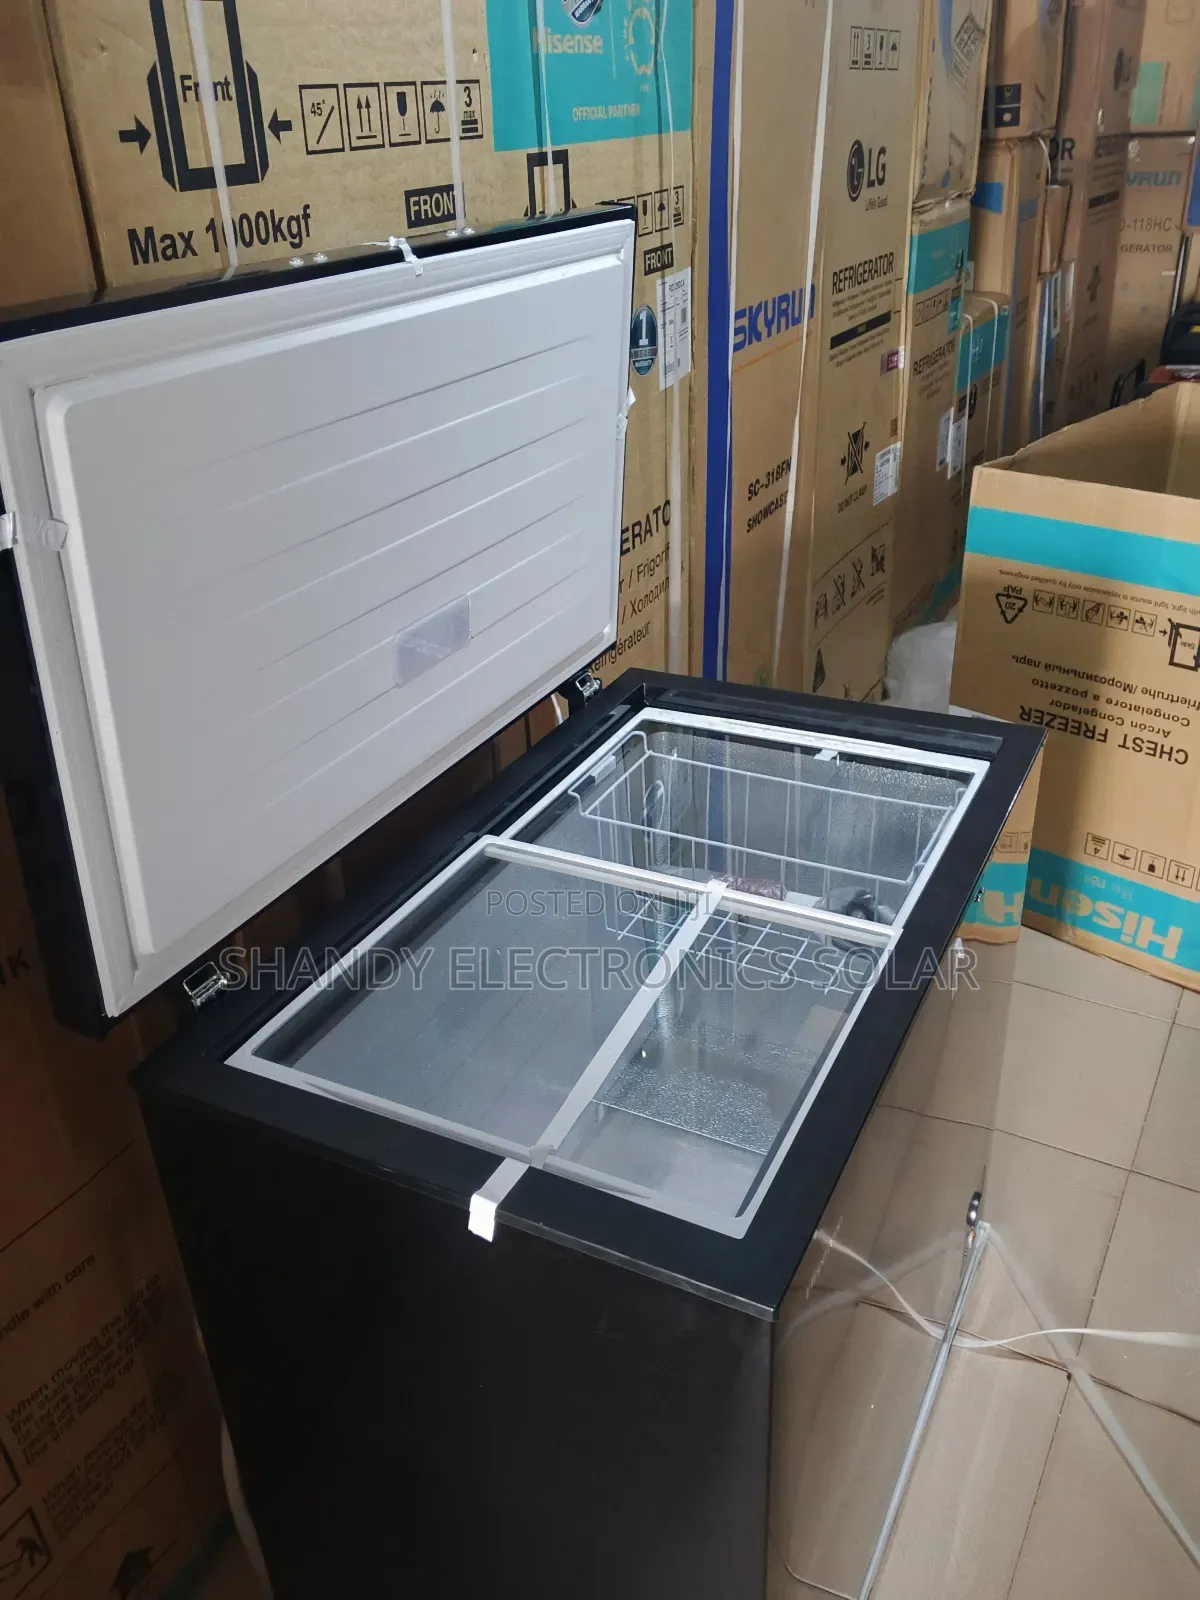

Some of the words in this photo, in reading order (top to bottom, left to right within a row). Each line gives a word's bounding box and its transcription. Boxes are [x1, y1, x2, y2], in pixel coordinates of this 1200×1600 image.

[179, 74, 233, 102] Frnt
[463, 86, 473, 108] 3
[463, 109, 476, 119] max
[572, 104, 607, 122] OFFICIAL
[609, 103, 640, 119] PARTNER
[866, 146, 887, 189] LG
[409, 190, 457, 221] FRON
[127, 226, 198, 266] Max
[645, 247, 673, 274] FRONT
[831, 251, 895, 296] REFRIGERATOR
[638, 310, 649, 346] 1
[1003, 584, 1023, 595] PAP
[1004, 602, 1016, 611] 20
[1012, 654, 1042, 668] ларь
[1031, 678, 1089, 699] pozzetto
[1093, 693, 1101, 702] a
[1018, 705, 1109, 744] FREEZER
[1049, 698, 1125, 727] Congelador
[1105, 697, 1191, 728] Congelatore
[1130, 719, 1172, 739] Arcón
[1117, 733, 1190, 766] CHEST
[33, 1281, 62, 1310] with
[65, 1254, 96, 1284] care
[6, 1384, 49, 1423] When
[51, 1336, 107, 1384] moving
